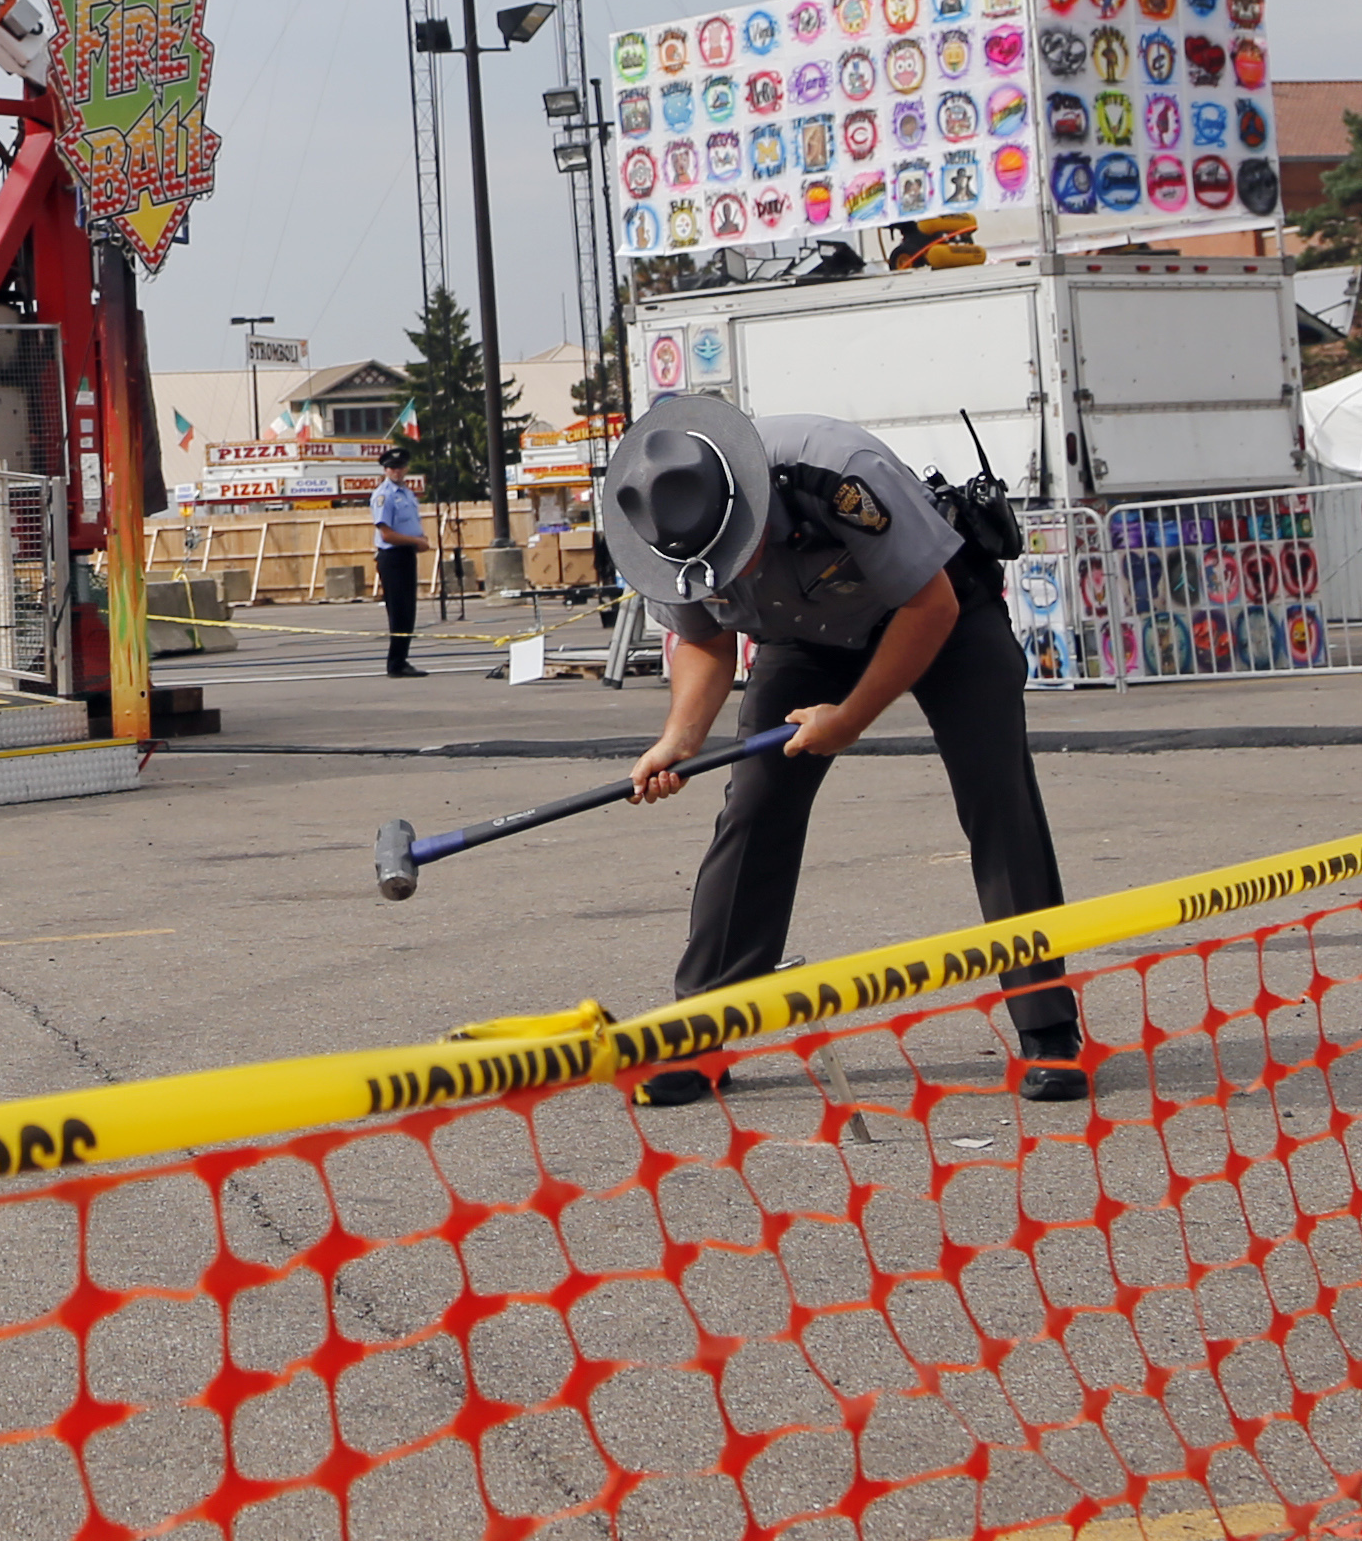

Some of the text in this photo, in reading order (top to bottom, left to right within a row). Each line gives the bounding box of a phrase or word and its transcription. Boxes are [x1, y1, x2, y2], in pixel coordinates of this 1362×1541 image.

[82, 97, 213, 222] BALL
[250, 342, 298, 363] STROMBOLI
[218, 445, 289, 460] PIZZA
[304, 444, 334, 455] PIZZA
[221, 483, 276, 497] PIZZA
